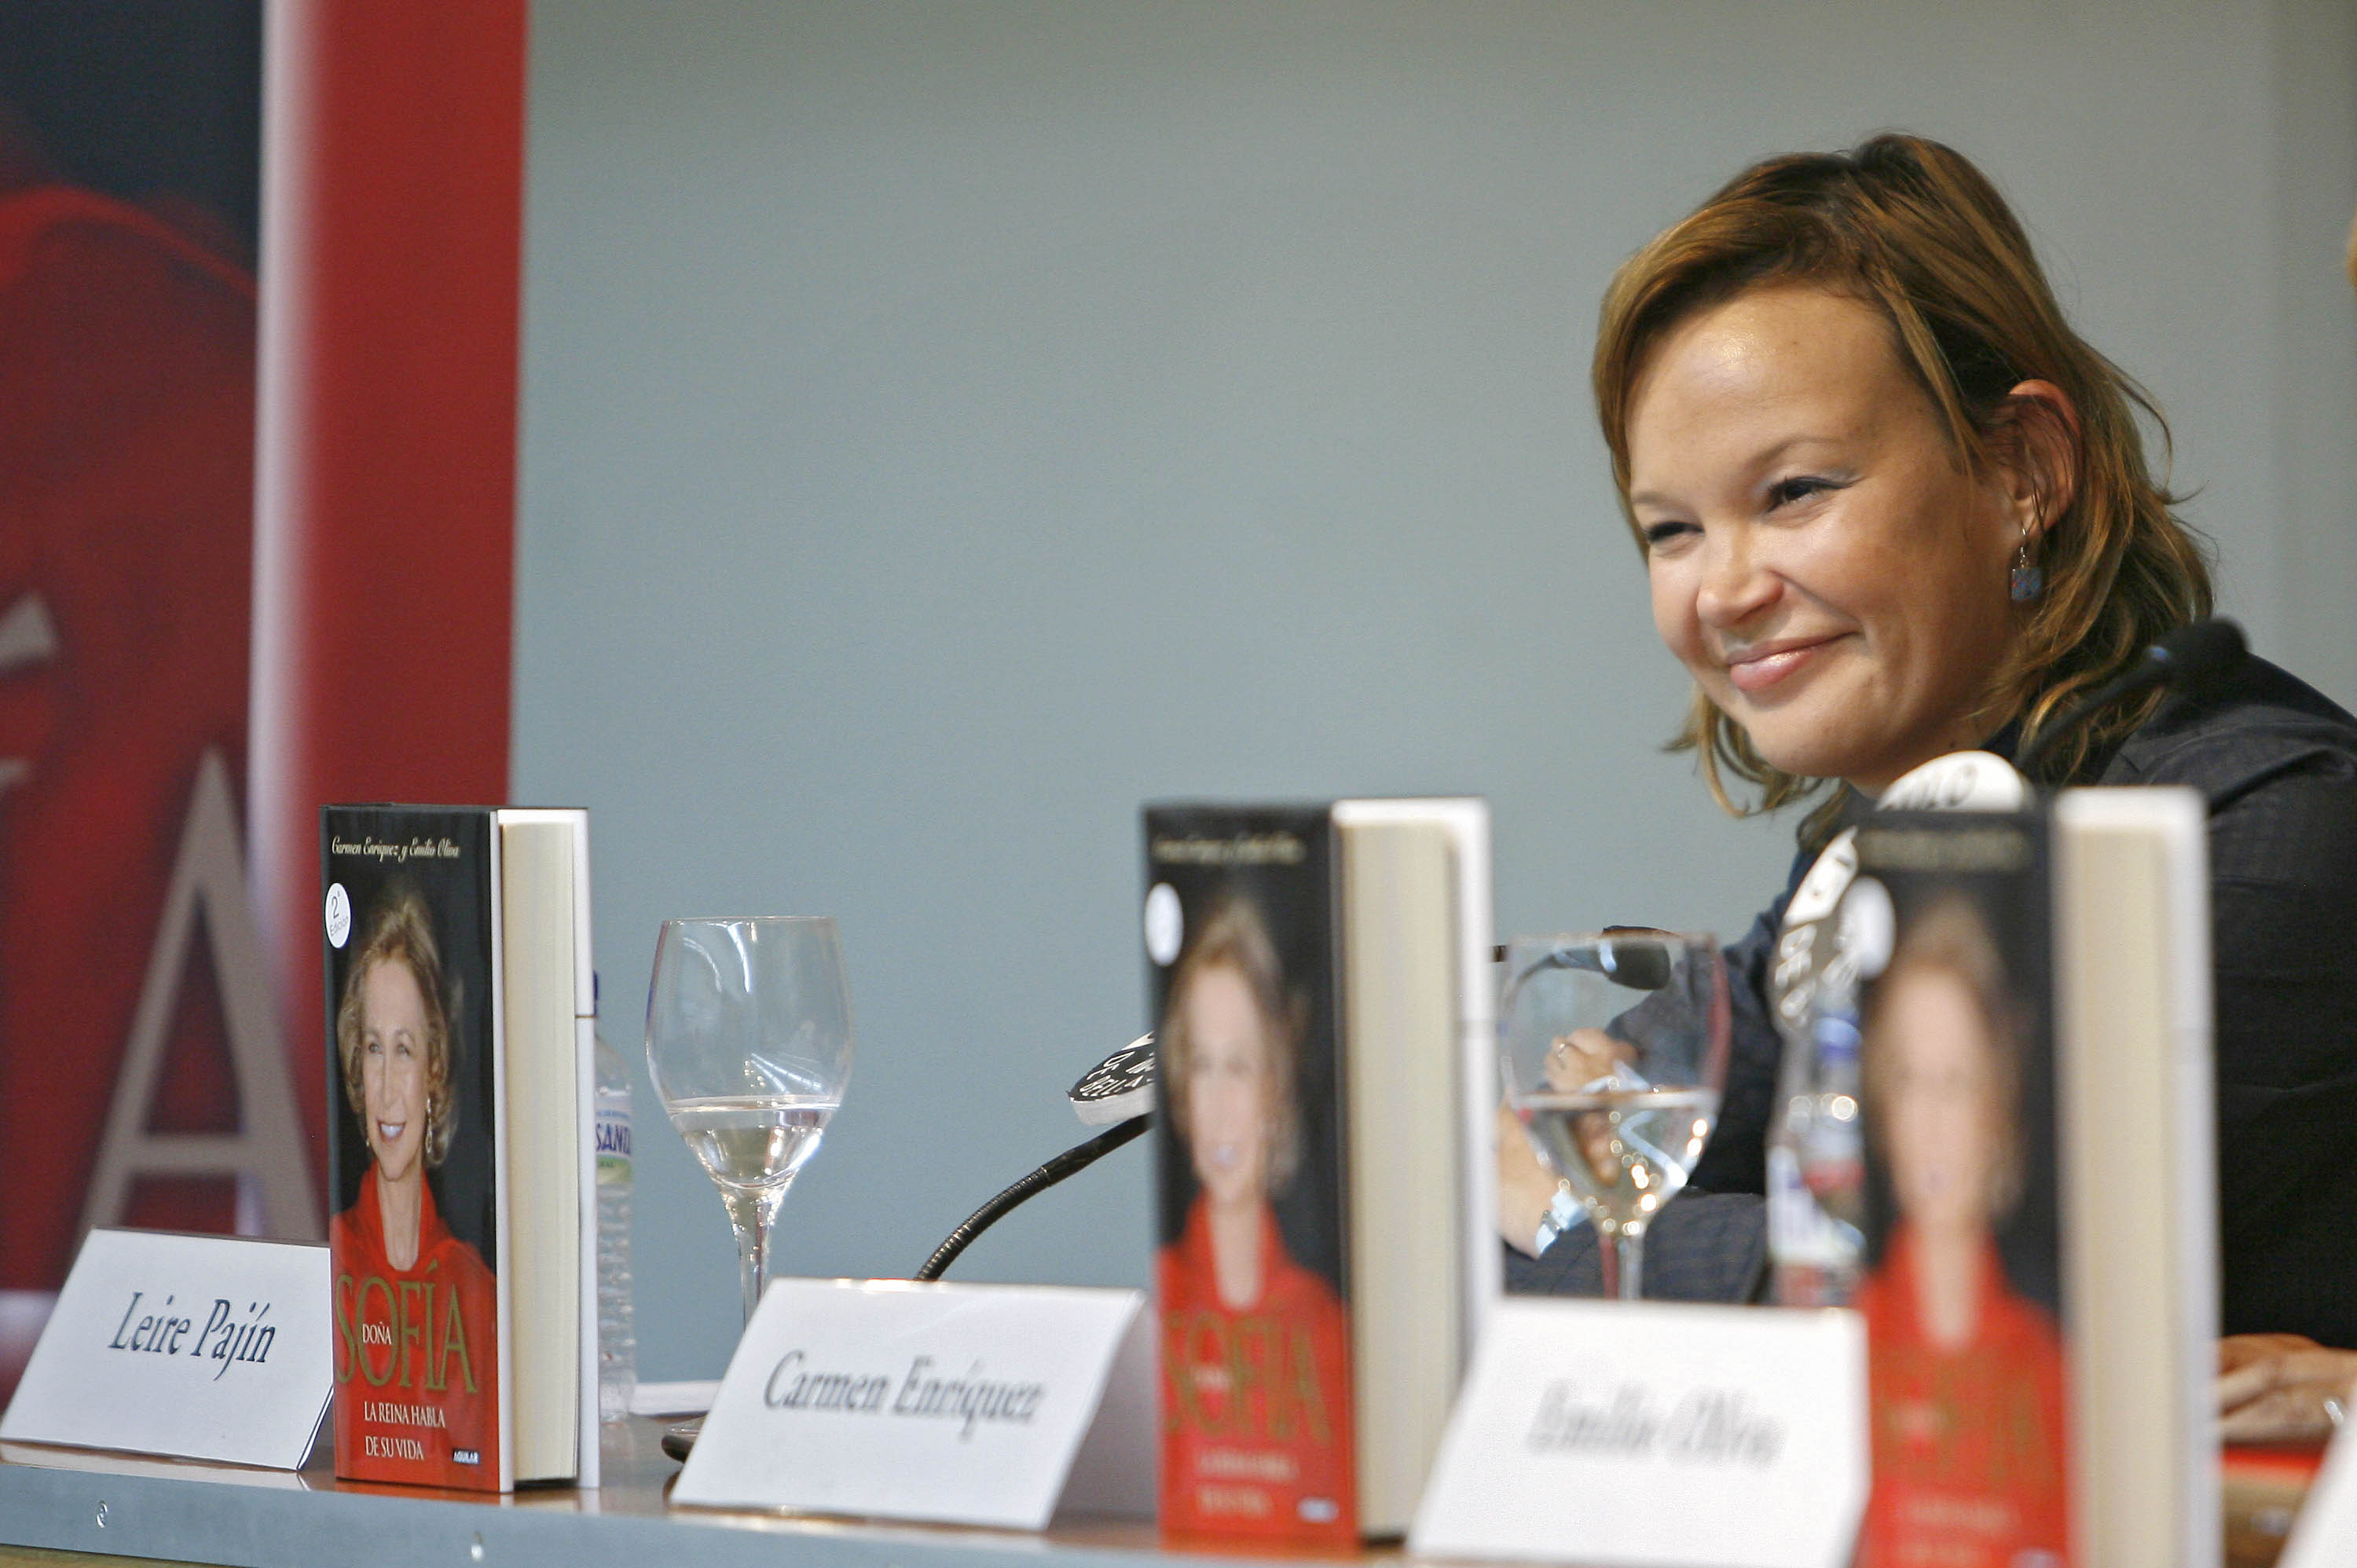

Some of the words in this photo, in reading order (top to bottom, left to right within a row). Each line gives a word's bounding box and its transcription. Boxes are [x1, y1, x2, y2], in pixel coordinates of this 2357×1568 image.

[332, 835, 361, 855] Carmen
[398, 844, 409, 863] y
[409, 837, 436, 857] Emilio
[437, 837, 460, 858] Oliva
[108, 1291, 191, 1355] Leire
[191, 1298, 277, 1381] Pajín
[335, 1258, 478, 1394] SOFÍA
[361, 1321, 392, 1345] DOÑA
[763, 1350, 889, 1412] Carmen
[893, 1356, 1049, 1442] Enríquez
[364, 1401, 377, 1422] LA
[379, 1402, 409, 1425] REINA
[411, 1405, 446, 1428] HABLA
[365, 1435, 379, 1456] DE
[380, 1437, 394, 1458] SU
[395, 1438, 424, 1461] VIDA
